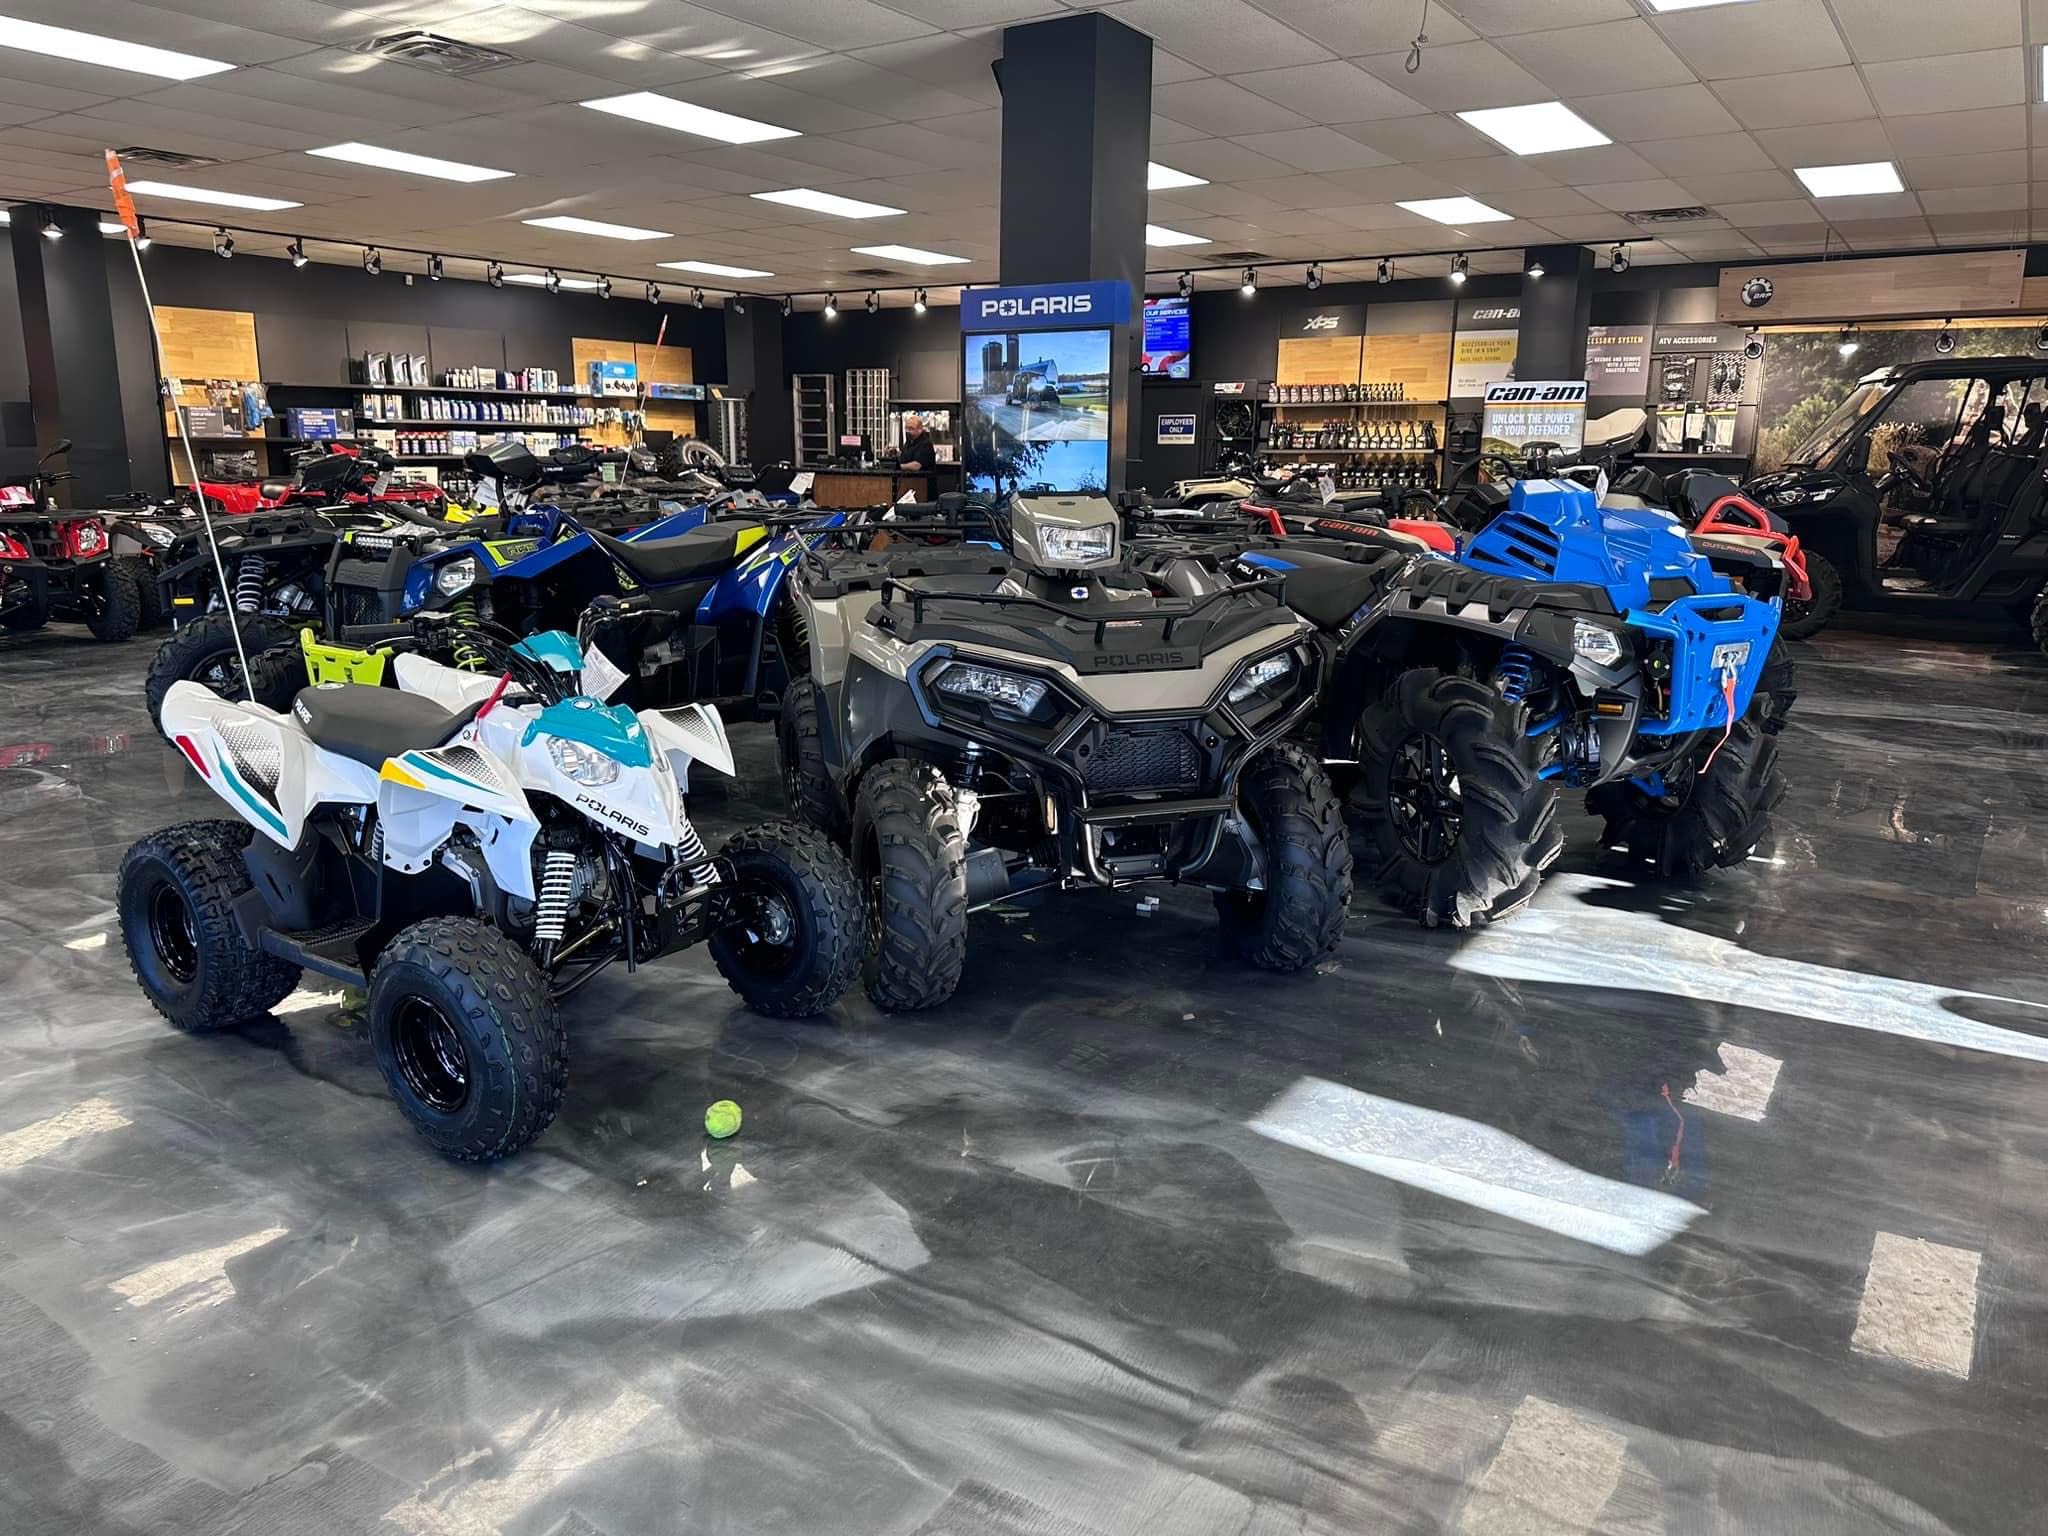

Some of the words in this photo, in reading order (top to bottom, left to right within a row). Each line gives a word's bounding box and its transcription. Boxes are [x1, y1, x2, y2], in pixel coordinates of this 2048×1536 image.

[982, 294, 1092, 317] POLARIS
[1160, 308, 1187, 316] SERVICES
[1472, 308, 1520, 320] can-a
[1618, 336, 1644, 344] SYSTEM
[1659, 337, 1672, 345] ATV
[1673, 336, 1717, 345] ACCESSORIES
[1487, 386, 1586, 401] can-am
[1161, 418, 1194, 426] EMPLOYEES
[1492, 413, 1525, 425] UNLOCK
[1527, 413, 1543, 424] THE
[1545, 413, 1575, 424] POWER
[1491, 426, 1503, 436] OF
[1504, 425, 1527, 436] YOUR
[1528, 425, 1570, 436] DEFENDER
[1094, 651, 1184, 668] POLARIS
[575, 793, 651, 836] POLARIS
